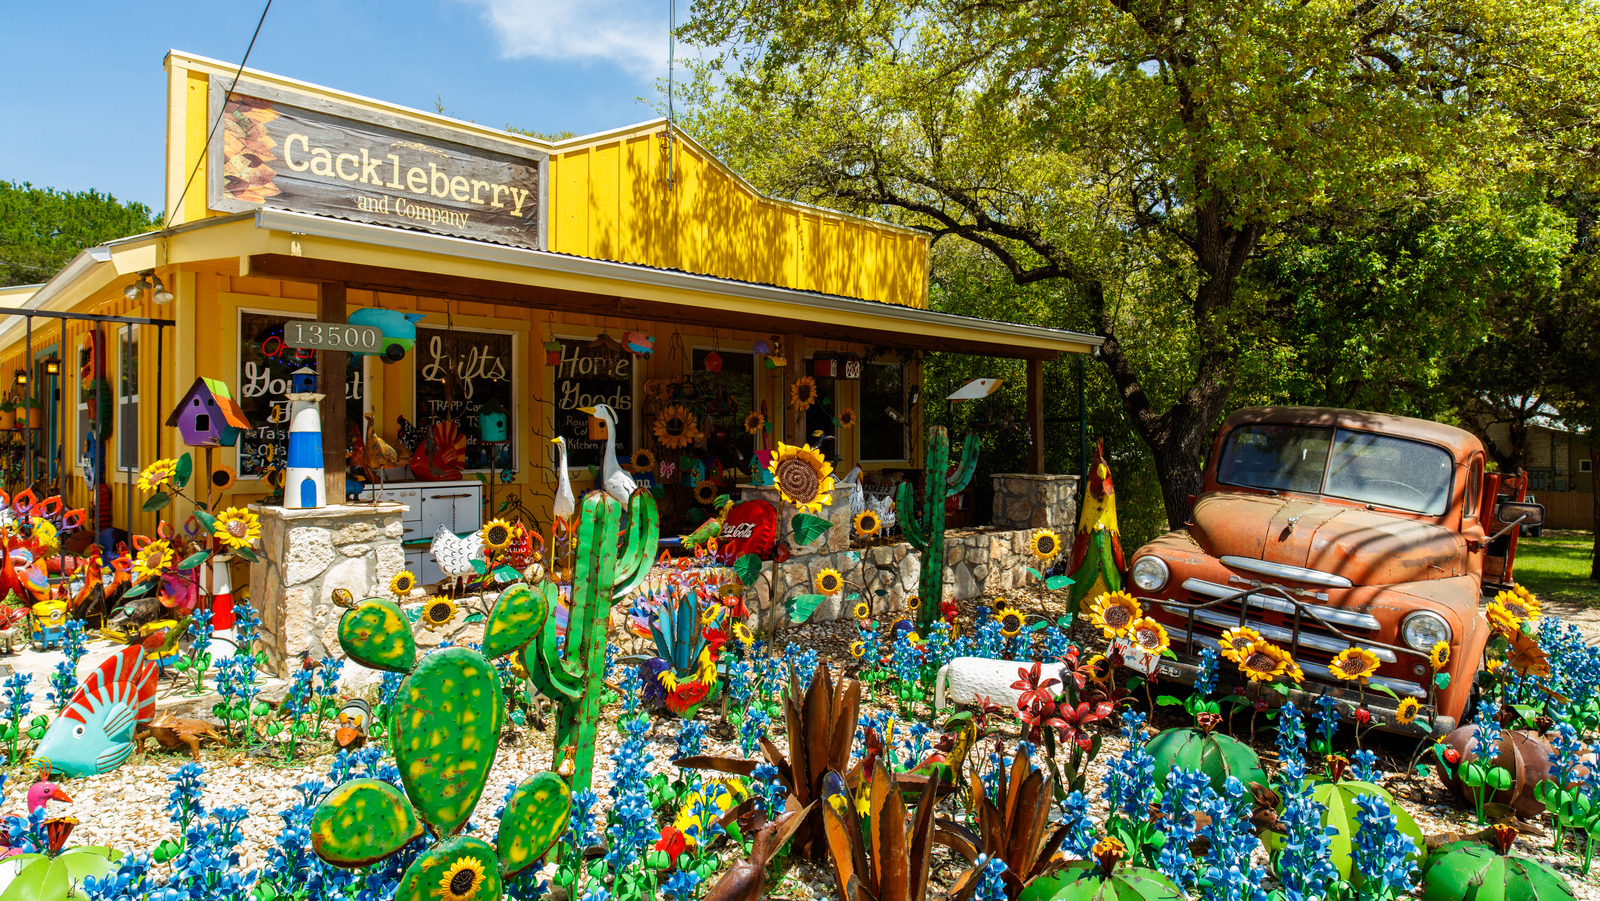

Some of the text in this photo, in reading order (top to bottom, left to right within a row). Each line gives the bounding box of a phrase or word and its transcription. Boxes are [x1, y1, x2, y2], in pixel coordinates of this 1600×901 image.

[284, 133, 529, 218] Cackleberry
[357, 195, 470, 230] and Company
[295, 324, 376, 348] 13500
[422, 336, 511, 399] Gifts
[567, 438, 599, 450] Kitchen
